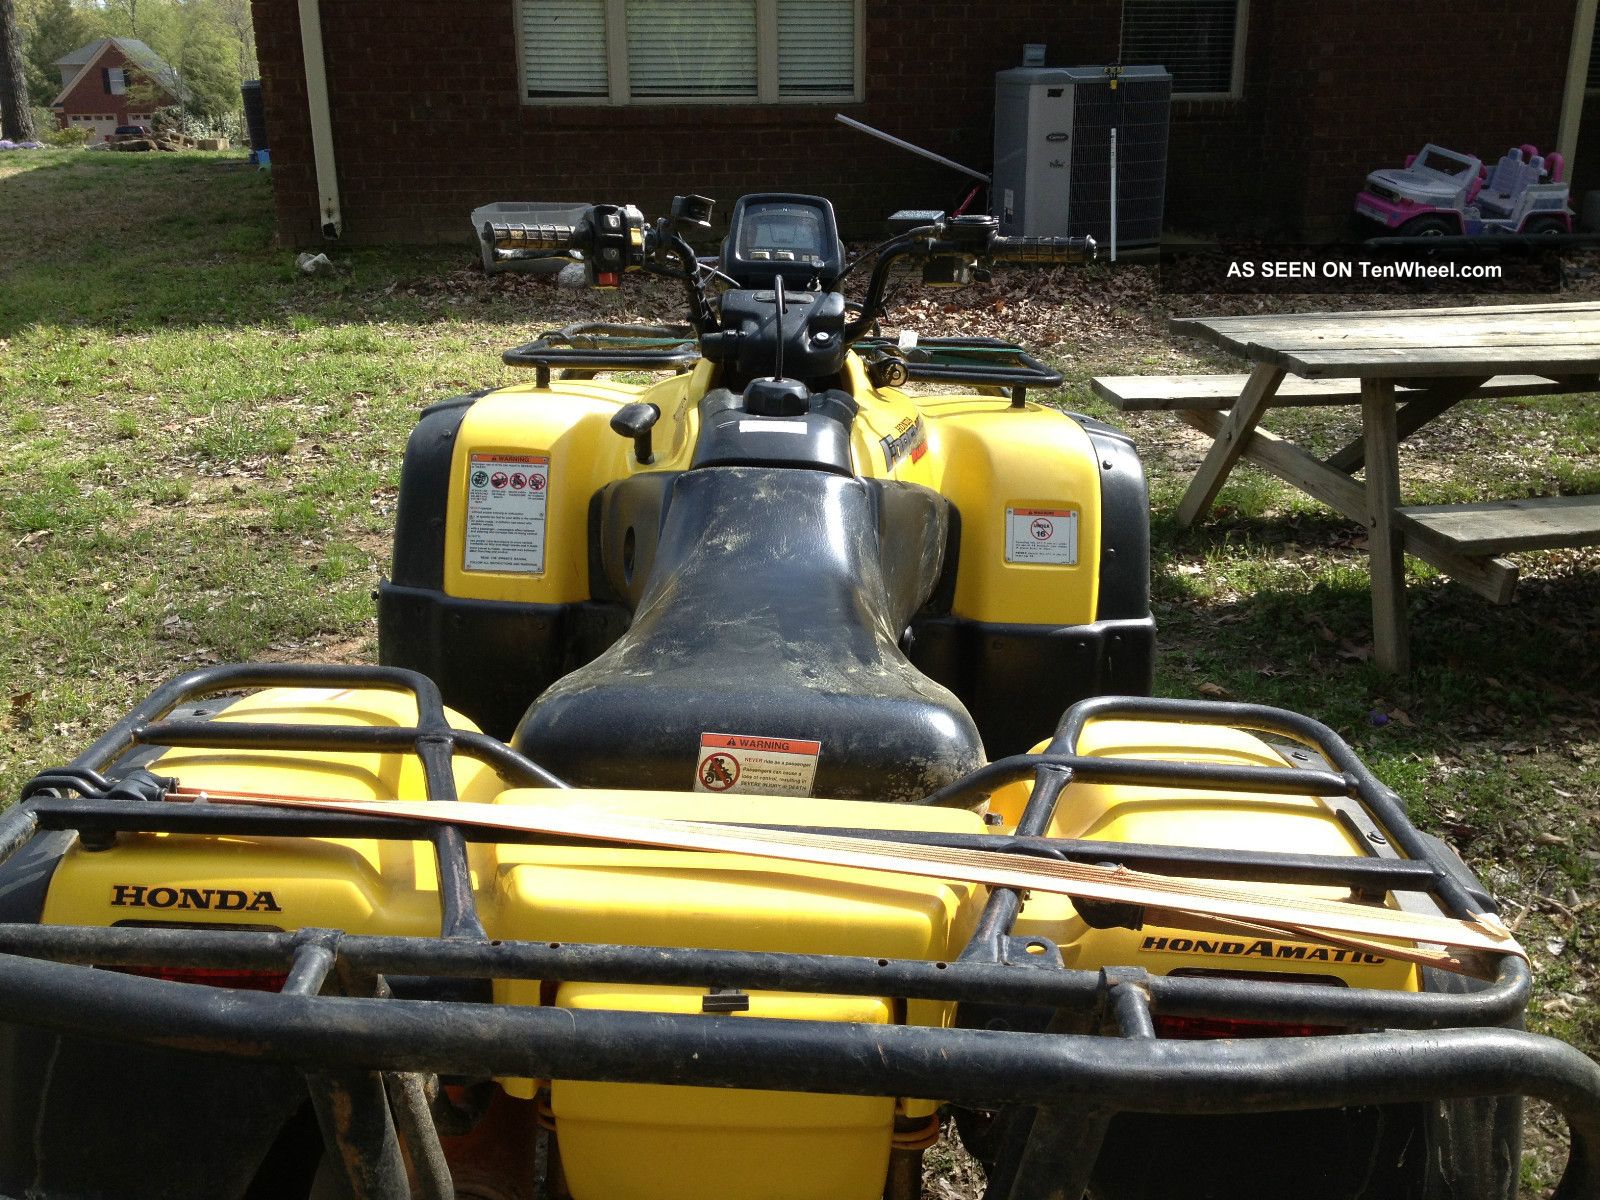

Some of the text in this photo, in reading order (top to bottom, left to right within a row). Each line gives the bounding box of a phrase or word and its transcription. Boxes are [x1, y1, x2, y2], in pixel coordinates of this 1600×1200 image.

[498, 455, 530, 463] WARNING
[739, 739, 790, 751] WARNING
[742, 766, 772, 774] Passengers
[111, 885, 282, 912] HONDA
